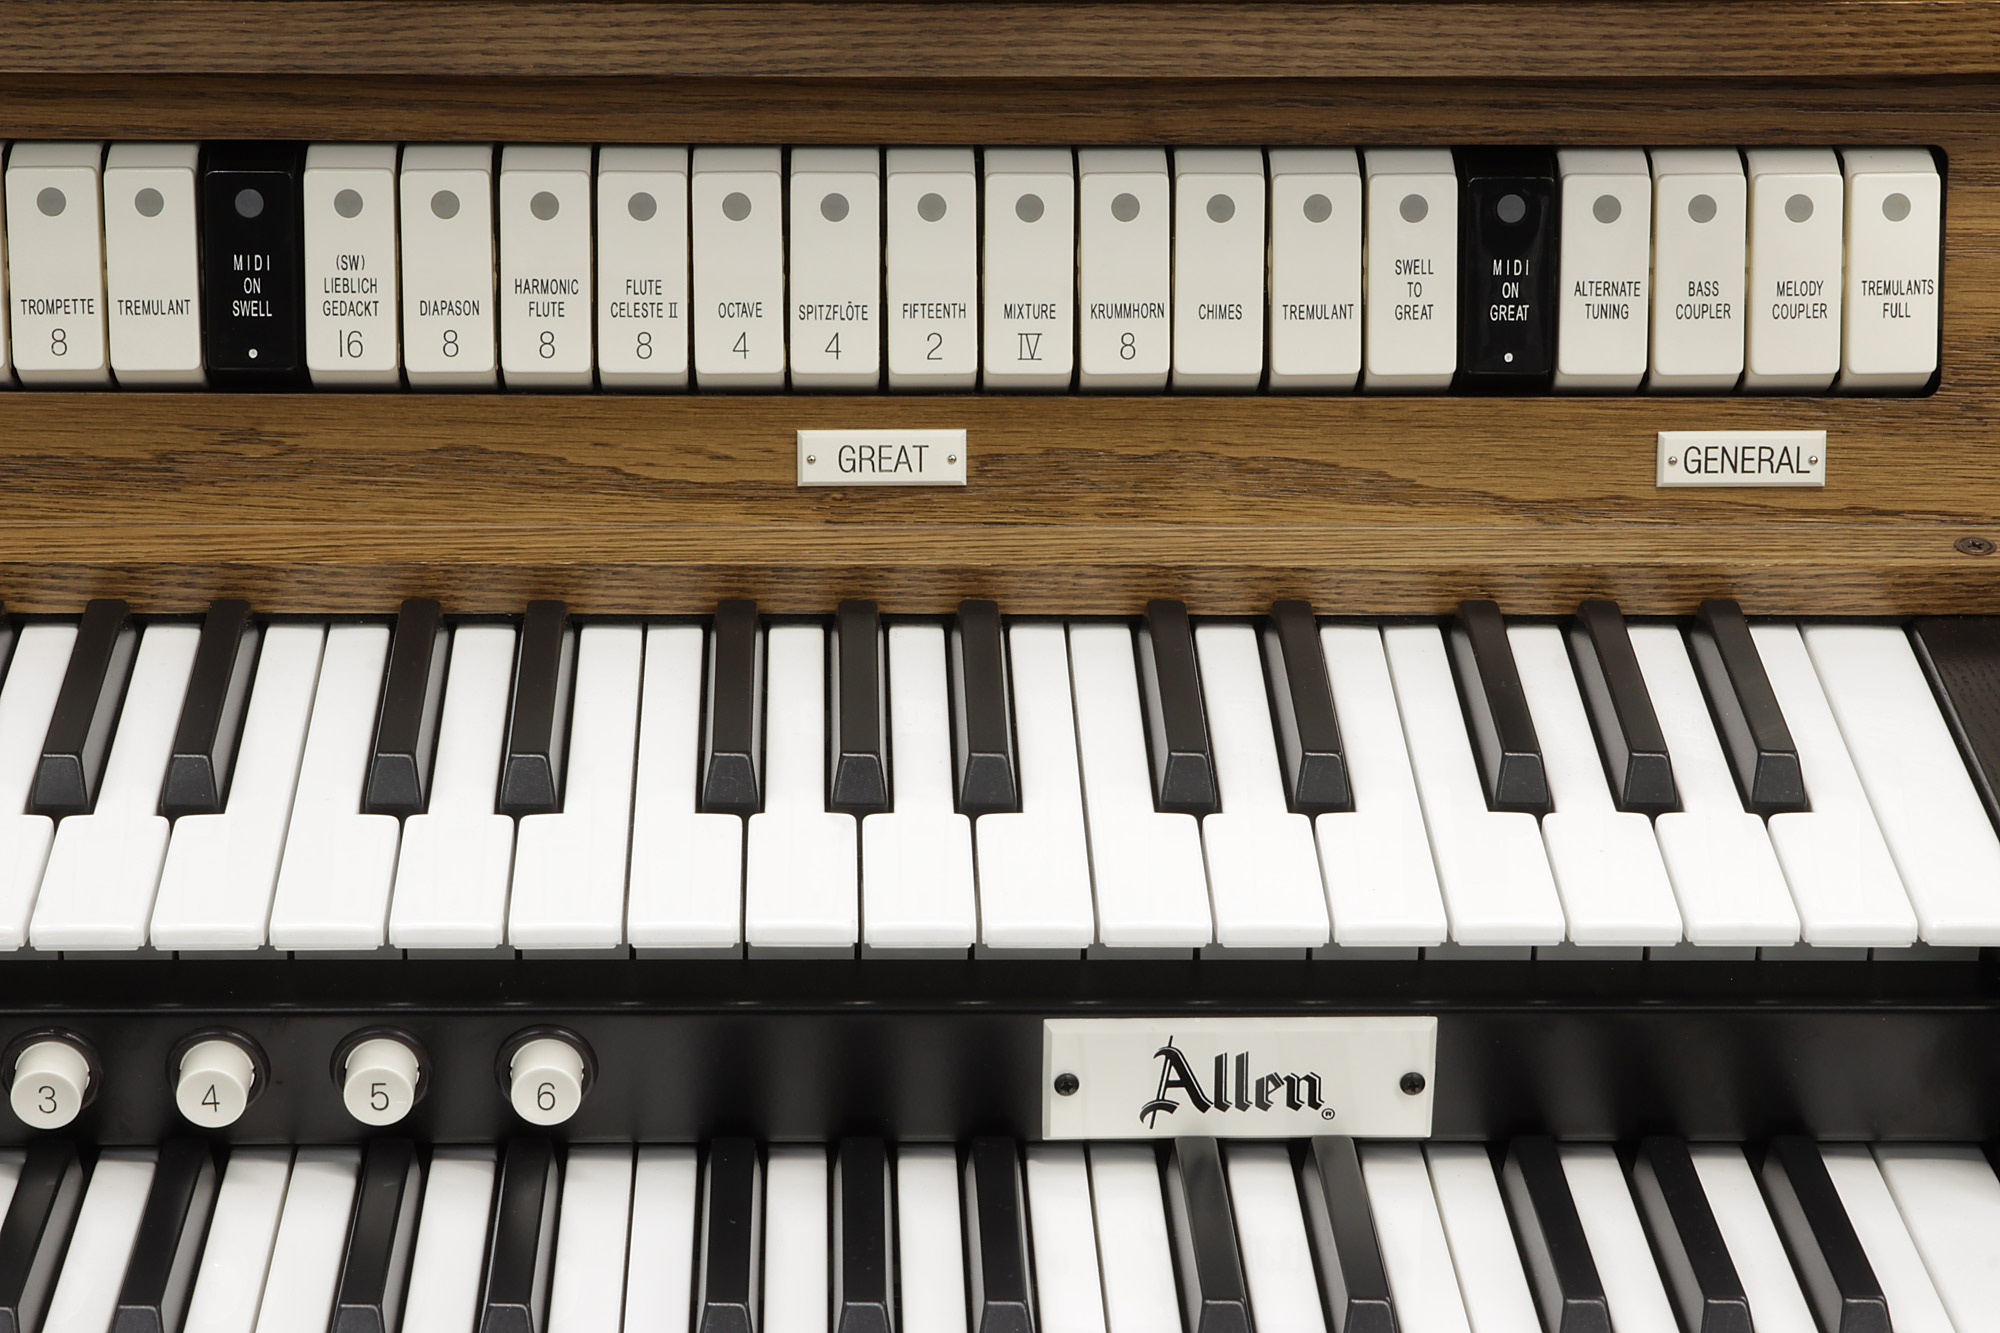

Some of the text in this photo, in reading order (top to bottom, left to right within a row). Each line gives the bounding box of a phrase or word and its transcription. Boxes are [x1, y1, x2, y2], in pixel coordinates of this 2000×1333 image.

[233, 253, 270, 272] MIDI
[335, 254, 366, 272] (SW)
[1394, 258, 1435, 276] SWELL
[1492, 258, 1529, 277] MIDI
[243, 276, 261, 295] ON
[323, 276, 378, 295] LIEBLICH
[514, 278, 580, 296] HARMONIC
[625, 278, 663, 296] FLUTE
[1406, 281, 1423, 298] TO
[1501, 281, 1520, 299] ON
[1573, 280, 1642, 298] ALTERNATE
[1688, 280, 1720, 297] BASS
[1776, 280, 1824, 297] MELODY
[1860, 278, 1935, 297] TREMULANTS
[20, 298, 95, 316] TROMPETTE
[116, 298, 191, 316] TREMULANT
[232, 299, 273, 318] SWELL
[322, 299, 380, 317] GEDACKT
[419, 299, 480, 317] DIAPASON
[528, 300, 566, 318] FLUTE
[610, 301, 679, 319] CELESTE II
[717, 301, 763, 319] OCTAVE
[902, 302, 967, 320] FIFTEENTH
[1003, 303, 1057, 320] MIXTURE
[1090, 302, 1165, 320] KRUMMHORN
[1198, 303, 1243, 321] CHIMES
[1281, 303, 1355, 321] TREMULANT
[1394, 303, 1435, 321] GREAT
[1489, 304, 1530, 322] GREAT
[1584, 303, 1630, 320] TUNING
[1675, 302, 1732, 321] COUPLER
[1771, 302, 1828, 320] COUPLER
[1882, 301, 1912, 319] FULL
[50, 327, 68, 357] 8
[339, 329, 364, 359] 16
[442, 329, 460, 358] 8
[538, 330, 556, 359] 8
[635, 331, 653, 360] 8
[732, 331, 750, 360] 4
[824, 331, 842, 361] 4
[926, 332, 943, 361] 2
[1017, 332, 1043, 361] IV
[1119, 331, 1137, 361] 8
[837, 444, 930, 474] GREAT
[1683, 445, 1811, 475] GENERAL
[38, 1085, 58, 1115] 3
[200, 1083, 221, 1113] 4
[370, 1082, 390, 1112] 5
[536, 1081, 556, 1112] 6
